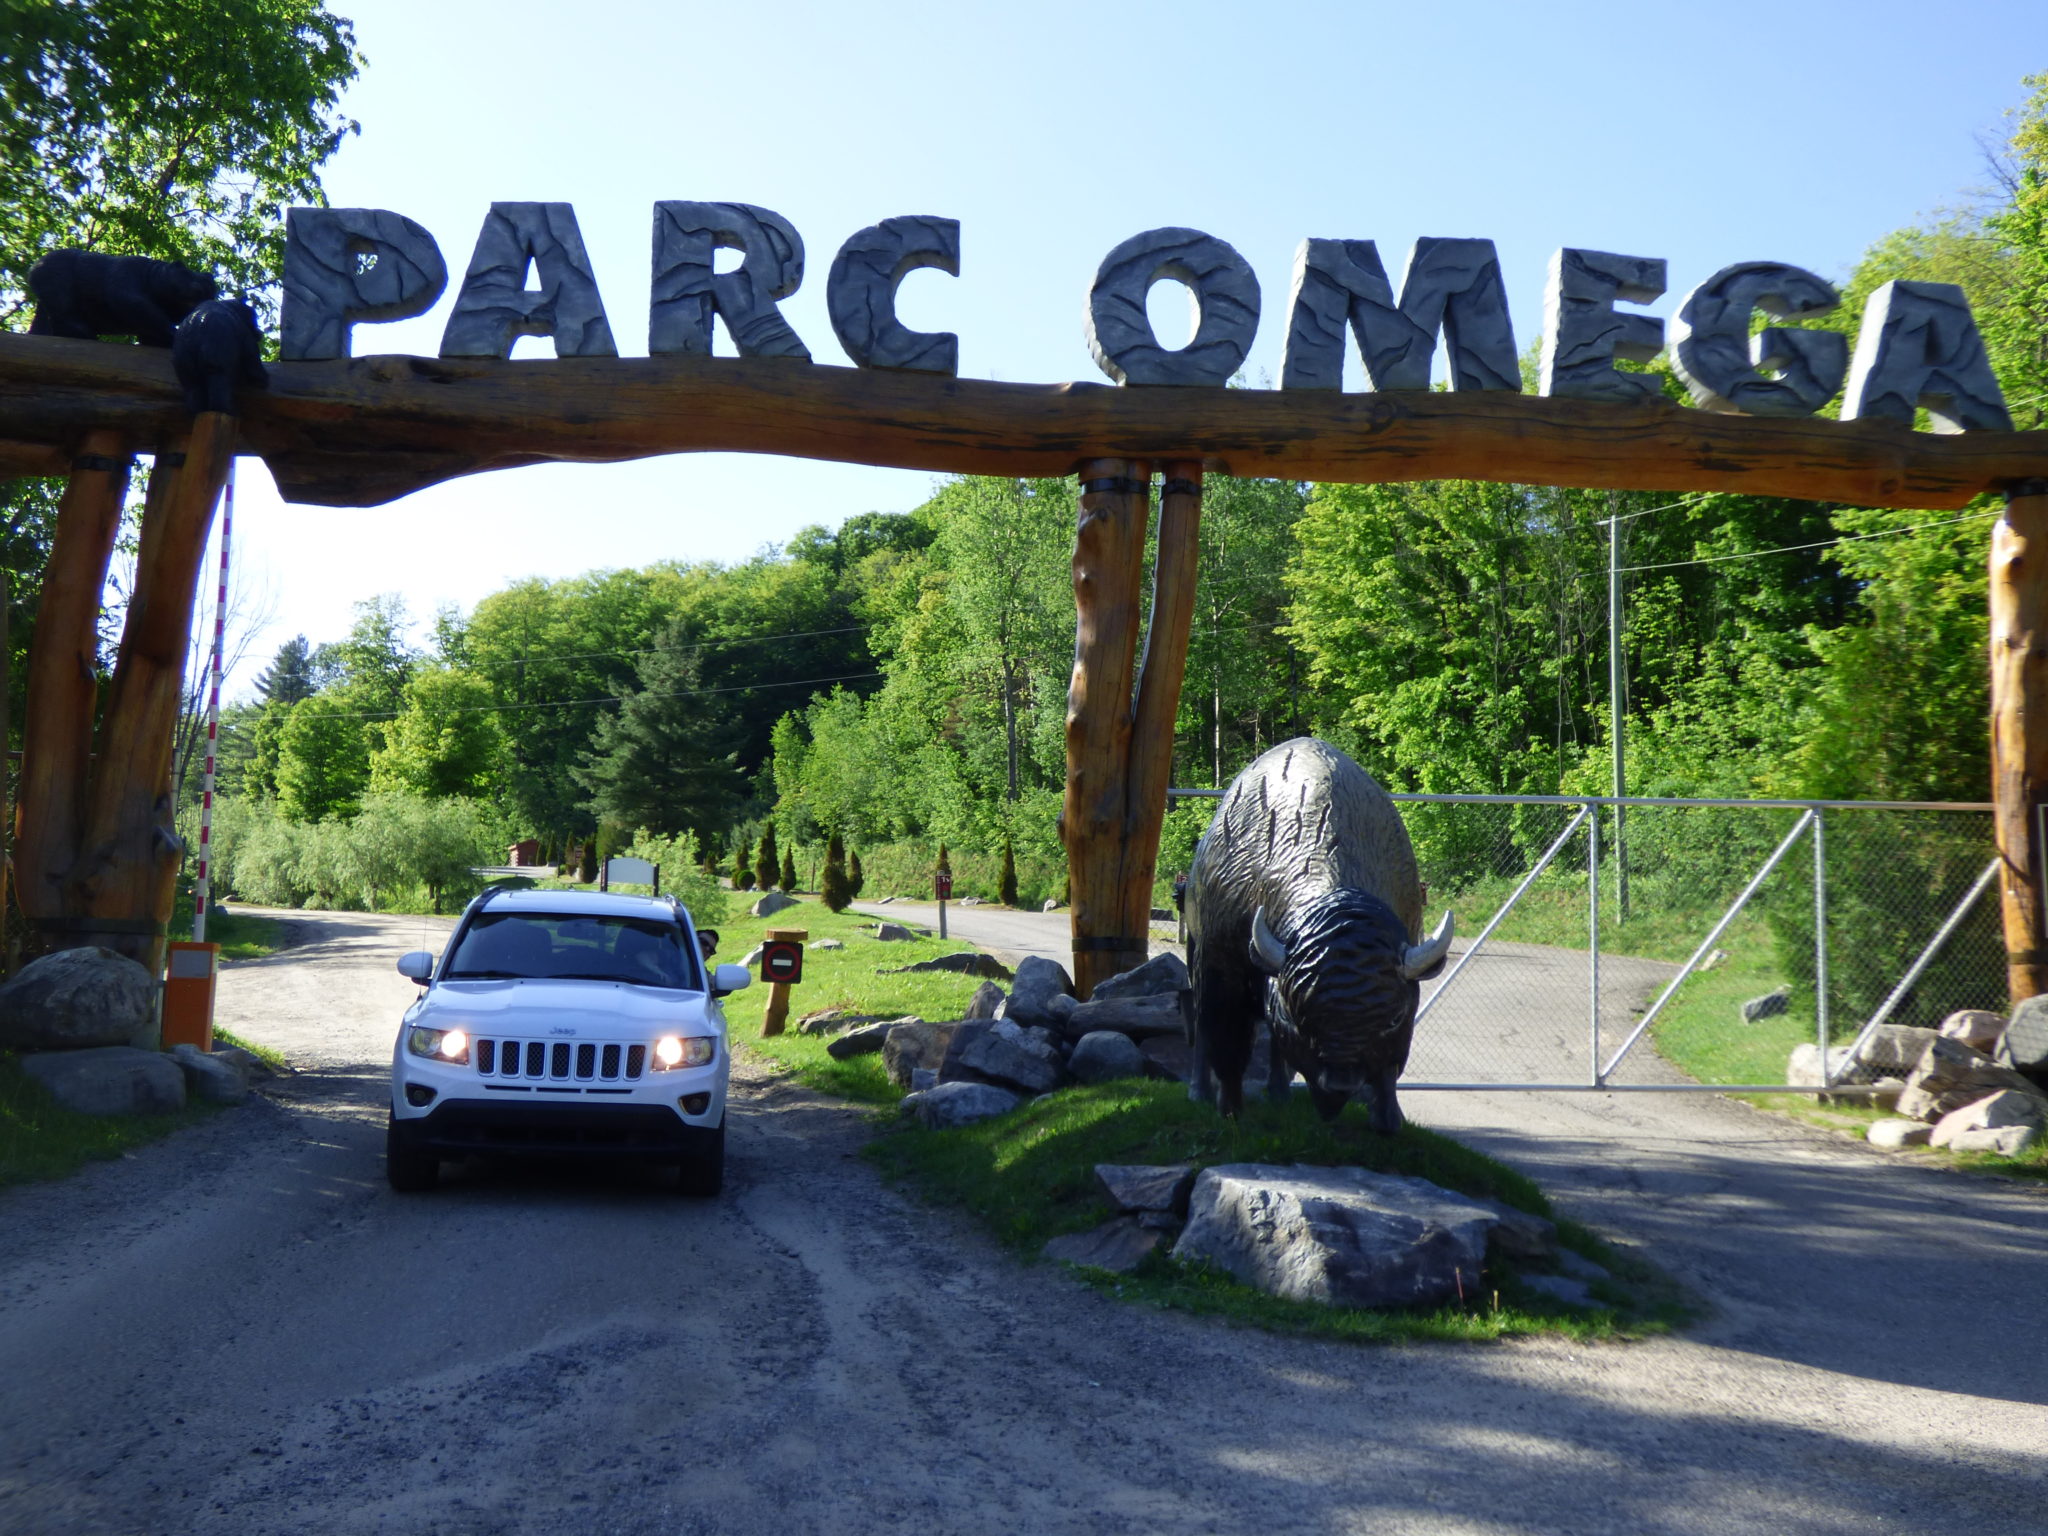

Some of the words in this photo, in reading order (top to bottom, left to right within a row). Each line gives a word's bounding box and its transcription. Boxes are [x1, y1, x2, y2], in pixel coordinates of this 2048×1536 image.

[279, 201, 961, 377] PARC
[1086, 226, 2015, 436] OMEGA
[549, 1026, 577, 1037] Jeep
